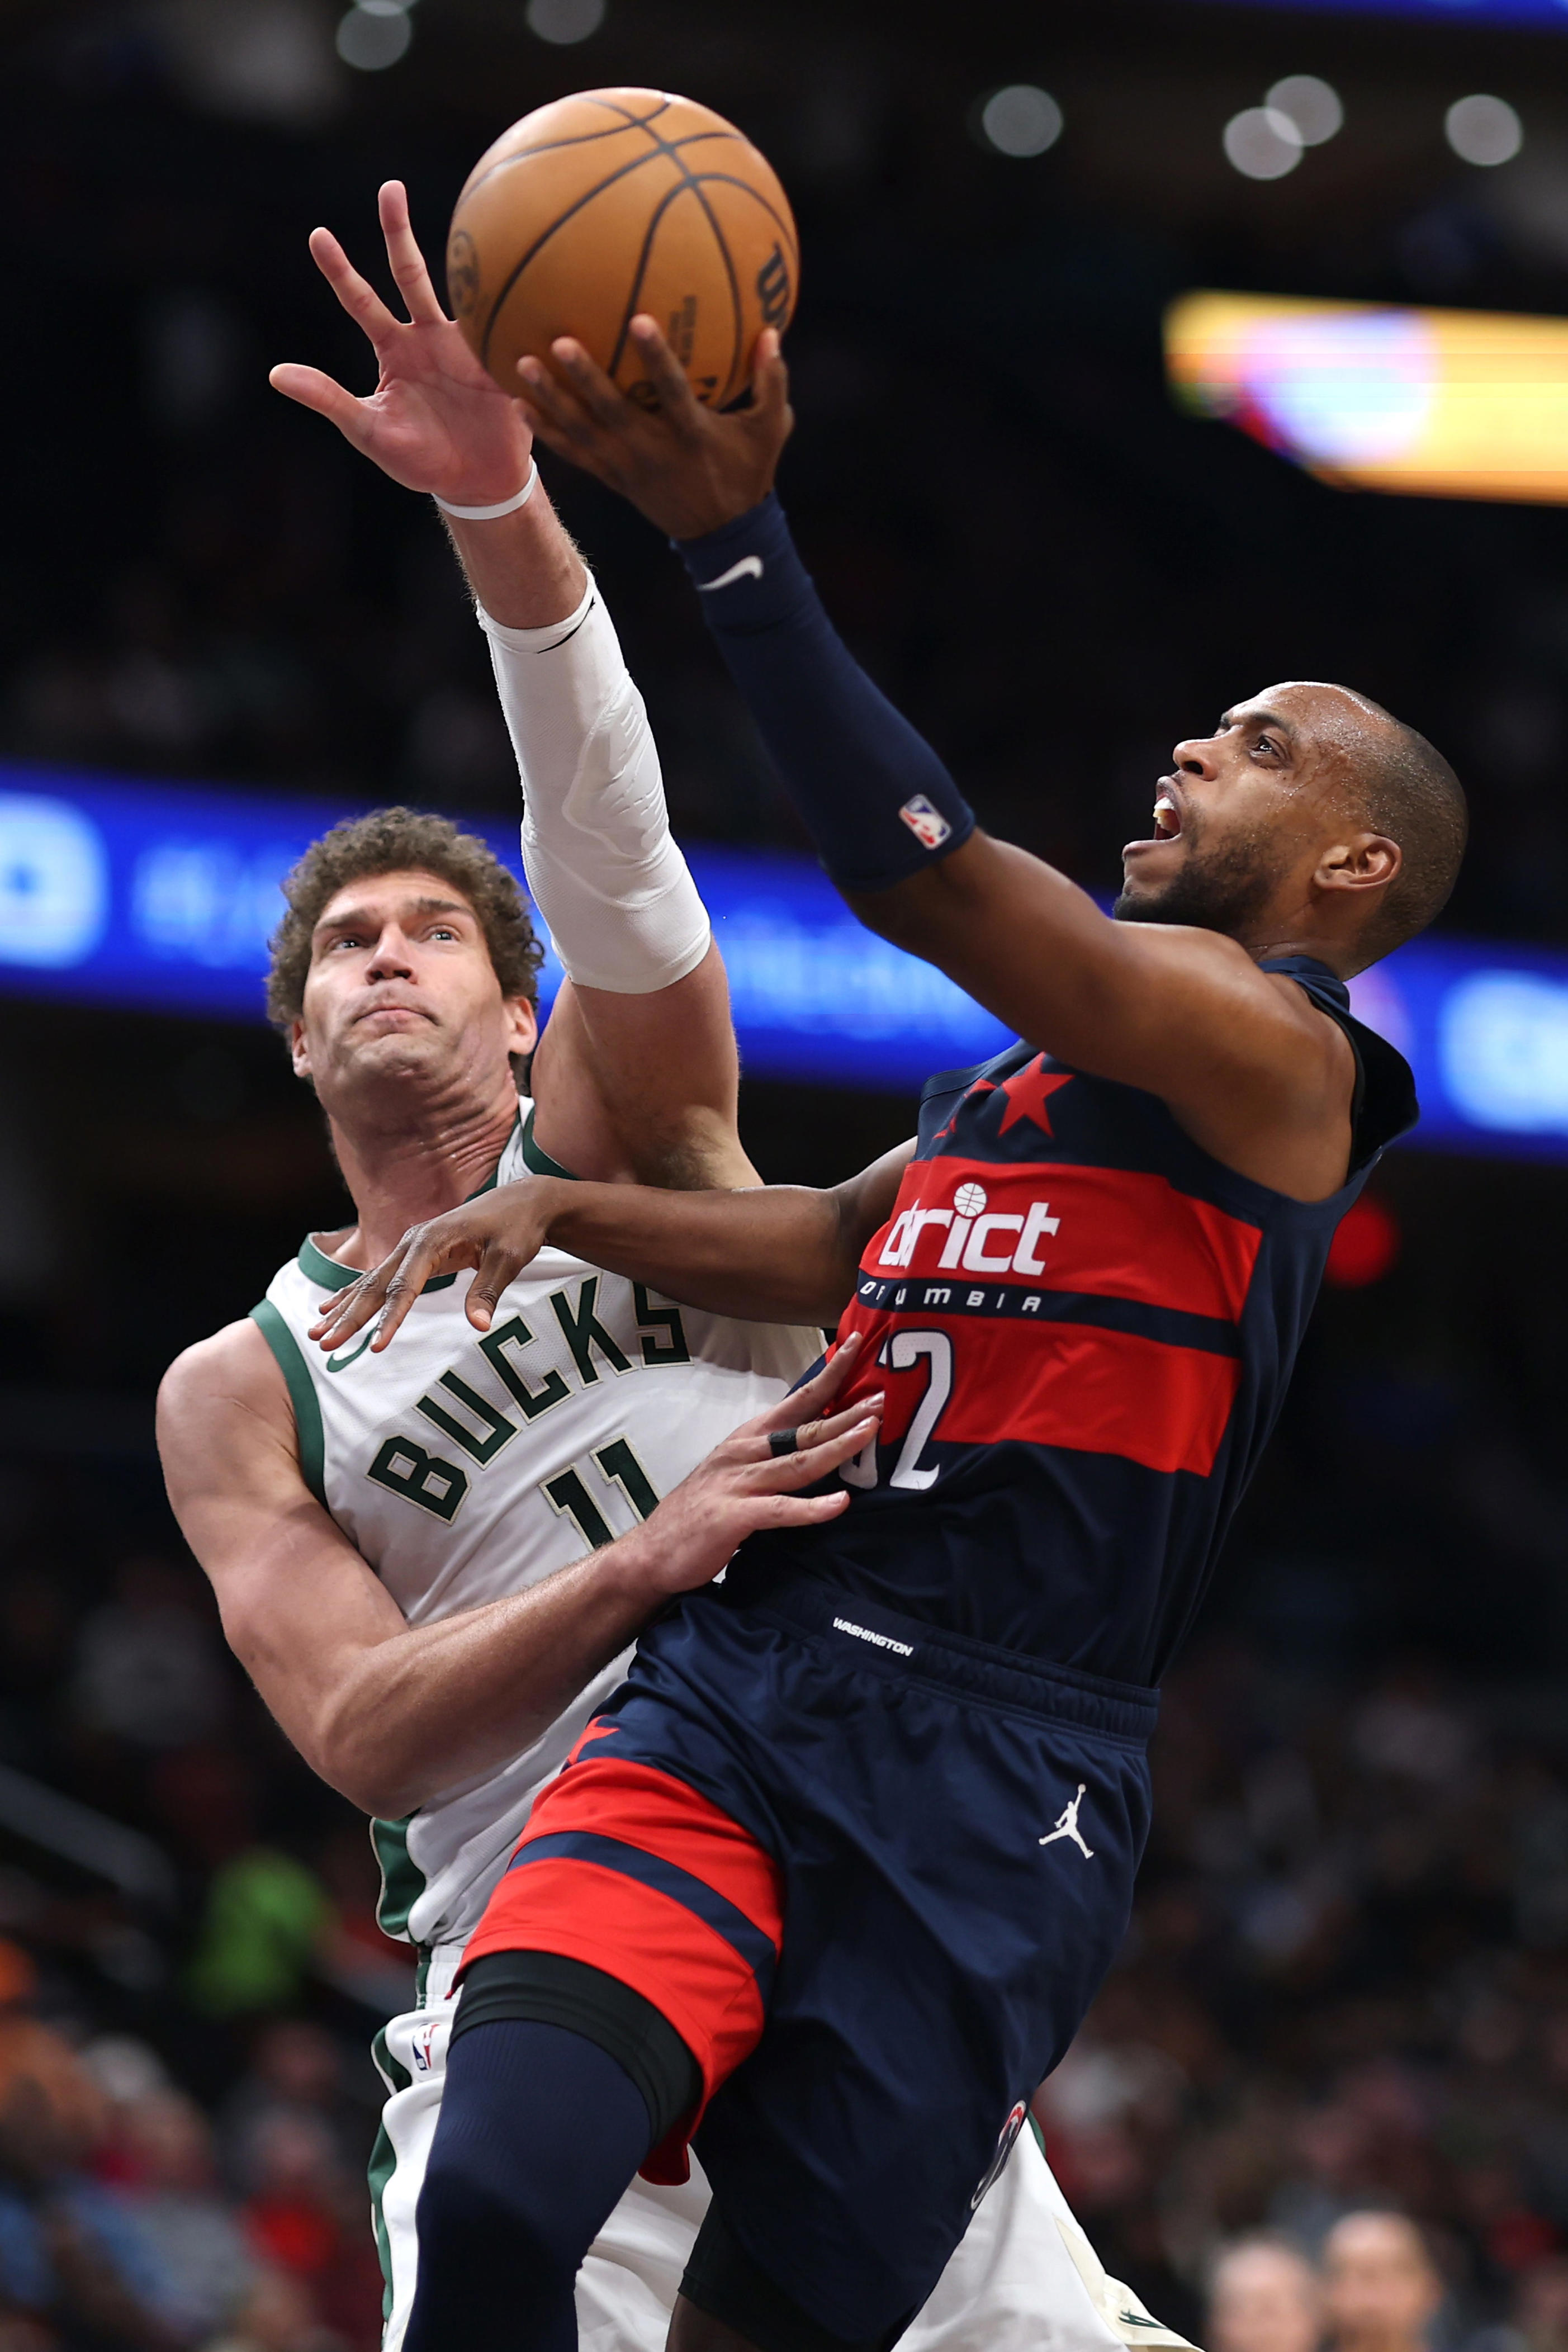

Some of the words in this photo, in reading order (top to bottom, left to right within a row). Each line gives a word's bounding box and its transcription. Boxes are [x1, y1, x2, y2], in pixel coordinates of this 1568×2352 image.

[364, 1269, 695, 1526] BUCKS
[538, 1433, 661, 1553] 11
[832, 1617, 914, 1657] WASHINGTON
